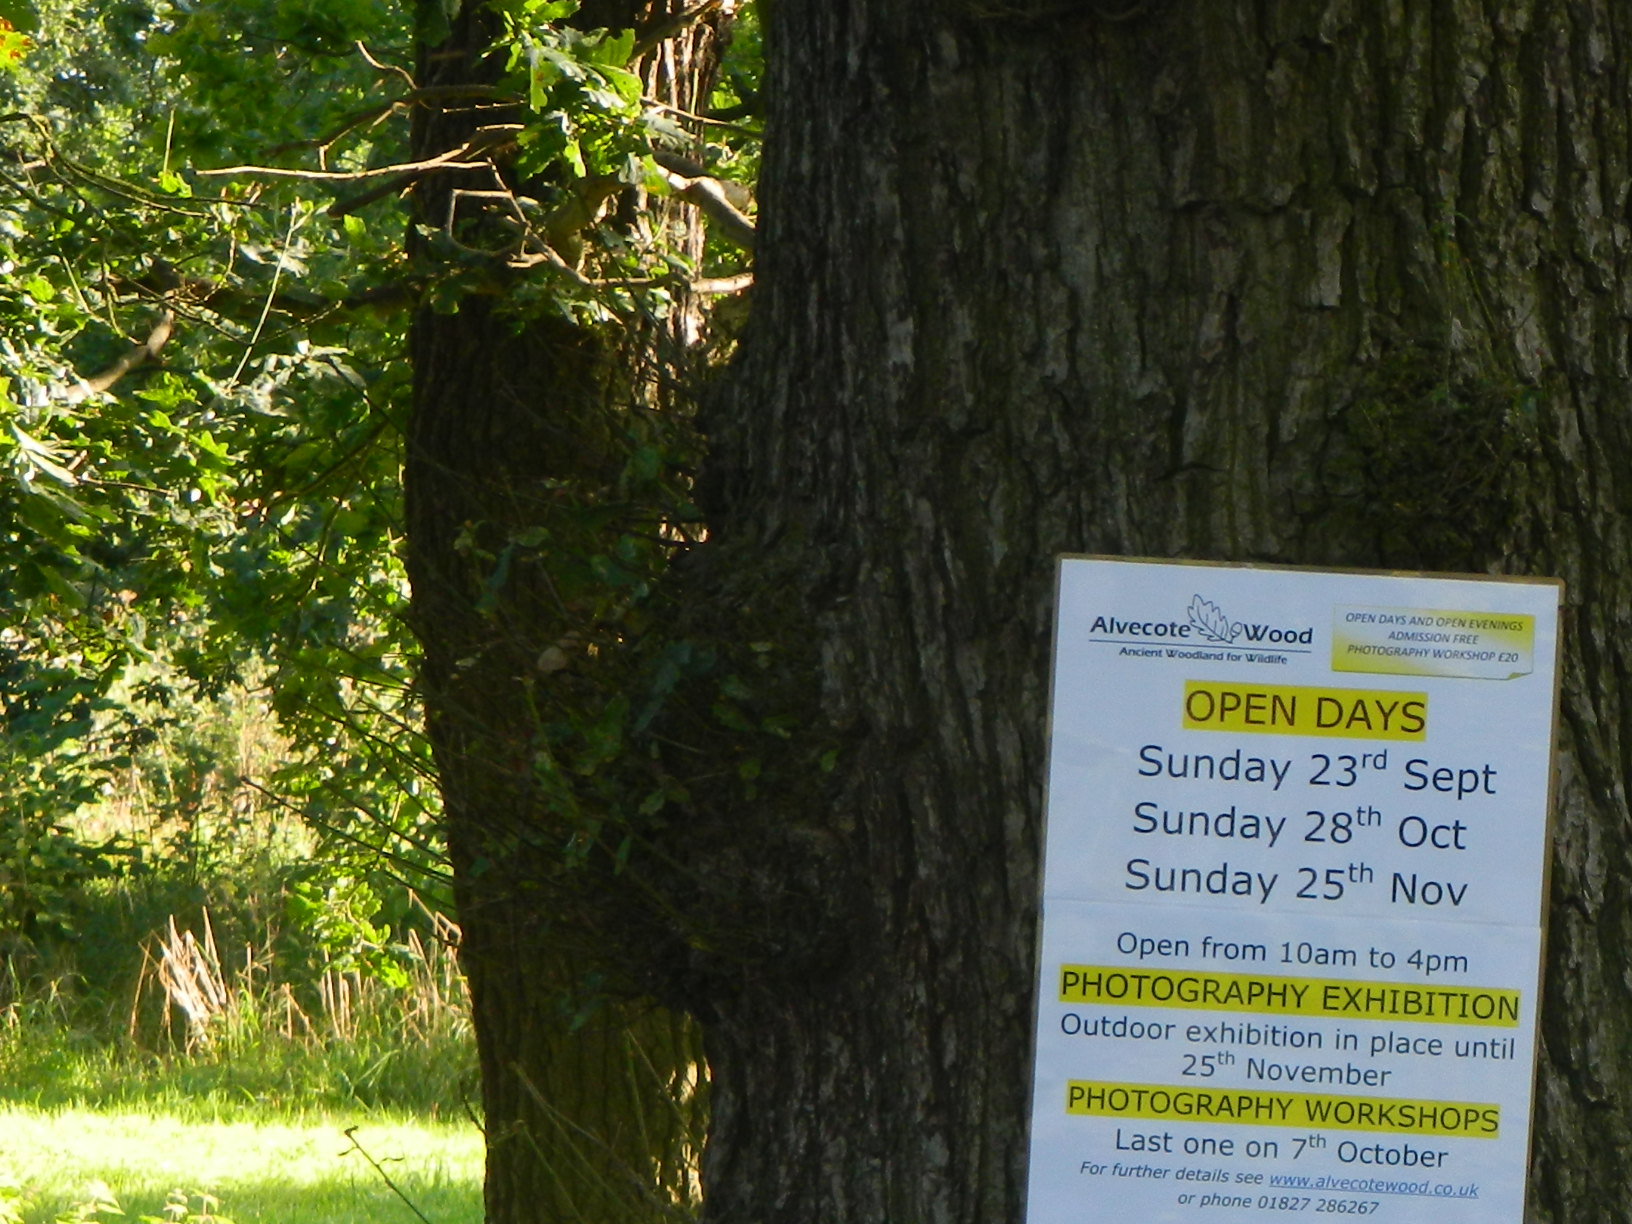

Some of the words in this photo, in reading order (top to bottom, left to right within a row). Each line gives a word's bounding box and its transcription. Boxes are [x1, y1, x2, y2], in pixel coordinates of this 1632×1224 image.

[1090, 616, 1191, 638] Alvecote
[1243, 623, 1313, 644] Wood
[1345, 612, 1376, 624] OPEN
[1378, 614, 1406, 625] DAYS
[1408, 616, 1434, 627] AND
[1436, 617, 1467, 629] OPEN
[1469, 619, 1523, 632] EVENINGS
[1388, 631, 1450, 643] ADMISSION
[1453, 634, 1480, 645] FREE
[1119, 646, 1162, 658] Ancient
[1166, 649, 1224, 661] Woodland
[1226, 651, 1242, 662] for
[1245, 653, 1287, 665] Wildlife
[1347, 644, 1431, 658] PHOTOGRAPHY
[1433, 649, 1496, 661] WORKSHOP
[1185, 689, 1297, 727] OPEN
[1316, 697, 1426, 734] DAYS
[1137, 745, 1292, 791] Sunday
[1309, 749, 1388, 787] 23rd
[1404, 760, 1498, 801] Sept
[1133, 802, 1286, 847] Sunday
[1304, 805, 1382, 844] 28th
[1398, 815, 1468, 851] Oct
[1125, 858, 1278, 904] Sunday
[1297, 862, 1374, 900] 25th
[1392, 872, 1469, 906] Nov
[1117, 932, 1190, 961] Open
[1201, 935, 1267, 962] from
[1280, 941, 1357, 968] 10am
[1369, 945, 1396, 969] to
[1407, 949, 1469, 977] 4pm
[1061, 971, 1310, 1010] PHOTOGRAPHY
[1323, 985, 1520, 1022] EXHIBITION
[1061, 1013, 1176, 1042] Outdoor
[1186, 1020, 1323, 1051] exhibition
[1336, 1026, 1359, 1052] in
[1371, 1028, 1443, 1058] place
[1455, 1034, 1515, 1061] until
[1181, 1050, 1236, 1078] 25th
[1247, 1057, 1392, 1088] November
[1069, 1085, 1294, 1121] PHOTOGRAPHY
[1306, 1098, 1499, 1133] WORKSHOPS
[1115, 1128, 1173, 1154] Last
[1184, 1135, 1234, 1157] one
[1246, 1138, 1279, 1159] on
[1292, 1135, 1327, 1161] 7th
[1337, 1140, 1449, 1170] October
[1080, 1162, 1106, 1176] For
[1112, 1164, 1170, 1181] further
[1175, 1167, 1230, 1184] details
[1235, 1172, 1263, 1185] see
[1269, 1173, 1479, 1199] www.alvecotewood.co.uk
[1178, 1193, 1197, 1206] or
[1200, 1193, 1252, 1211] phone
[1258, 1196, 1311, 1212] 01827
[1315, 1199, 1380, 1215] 286267
